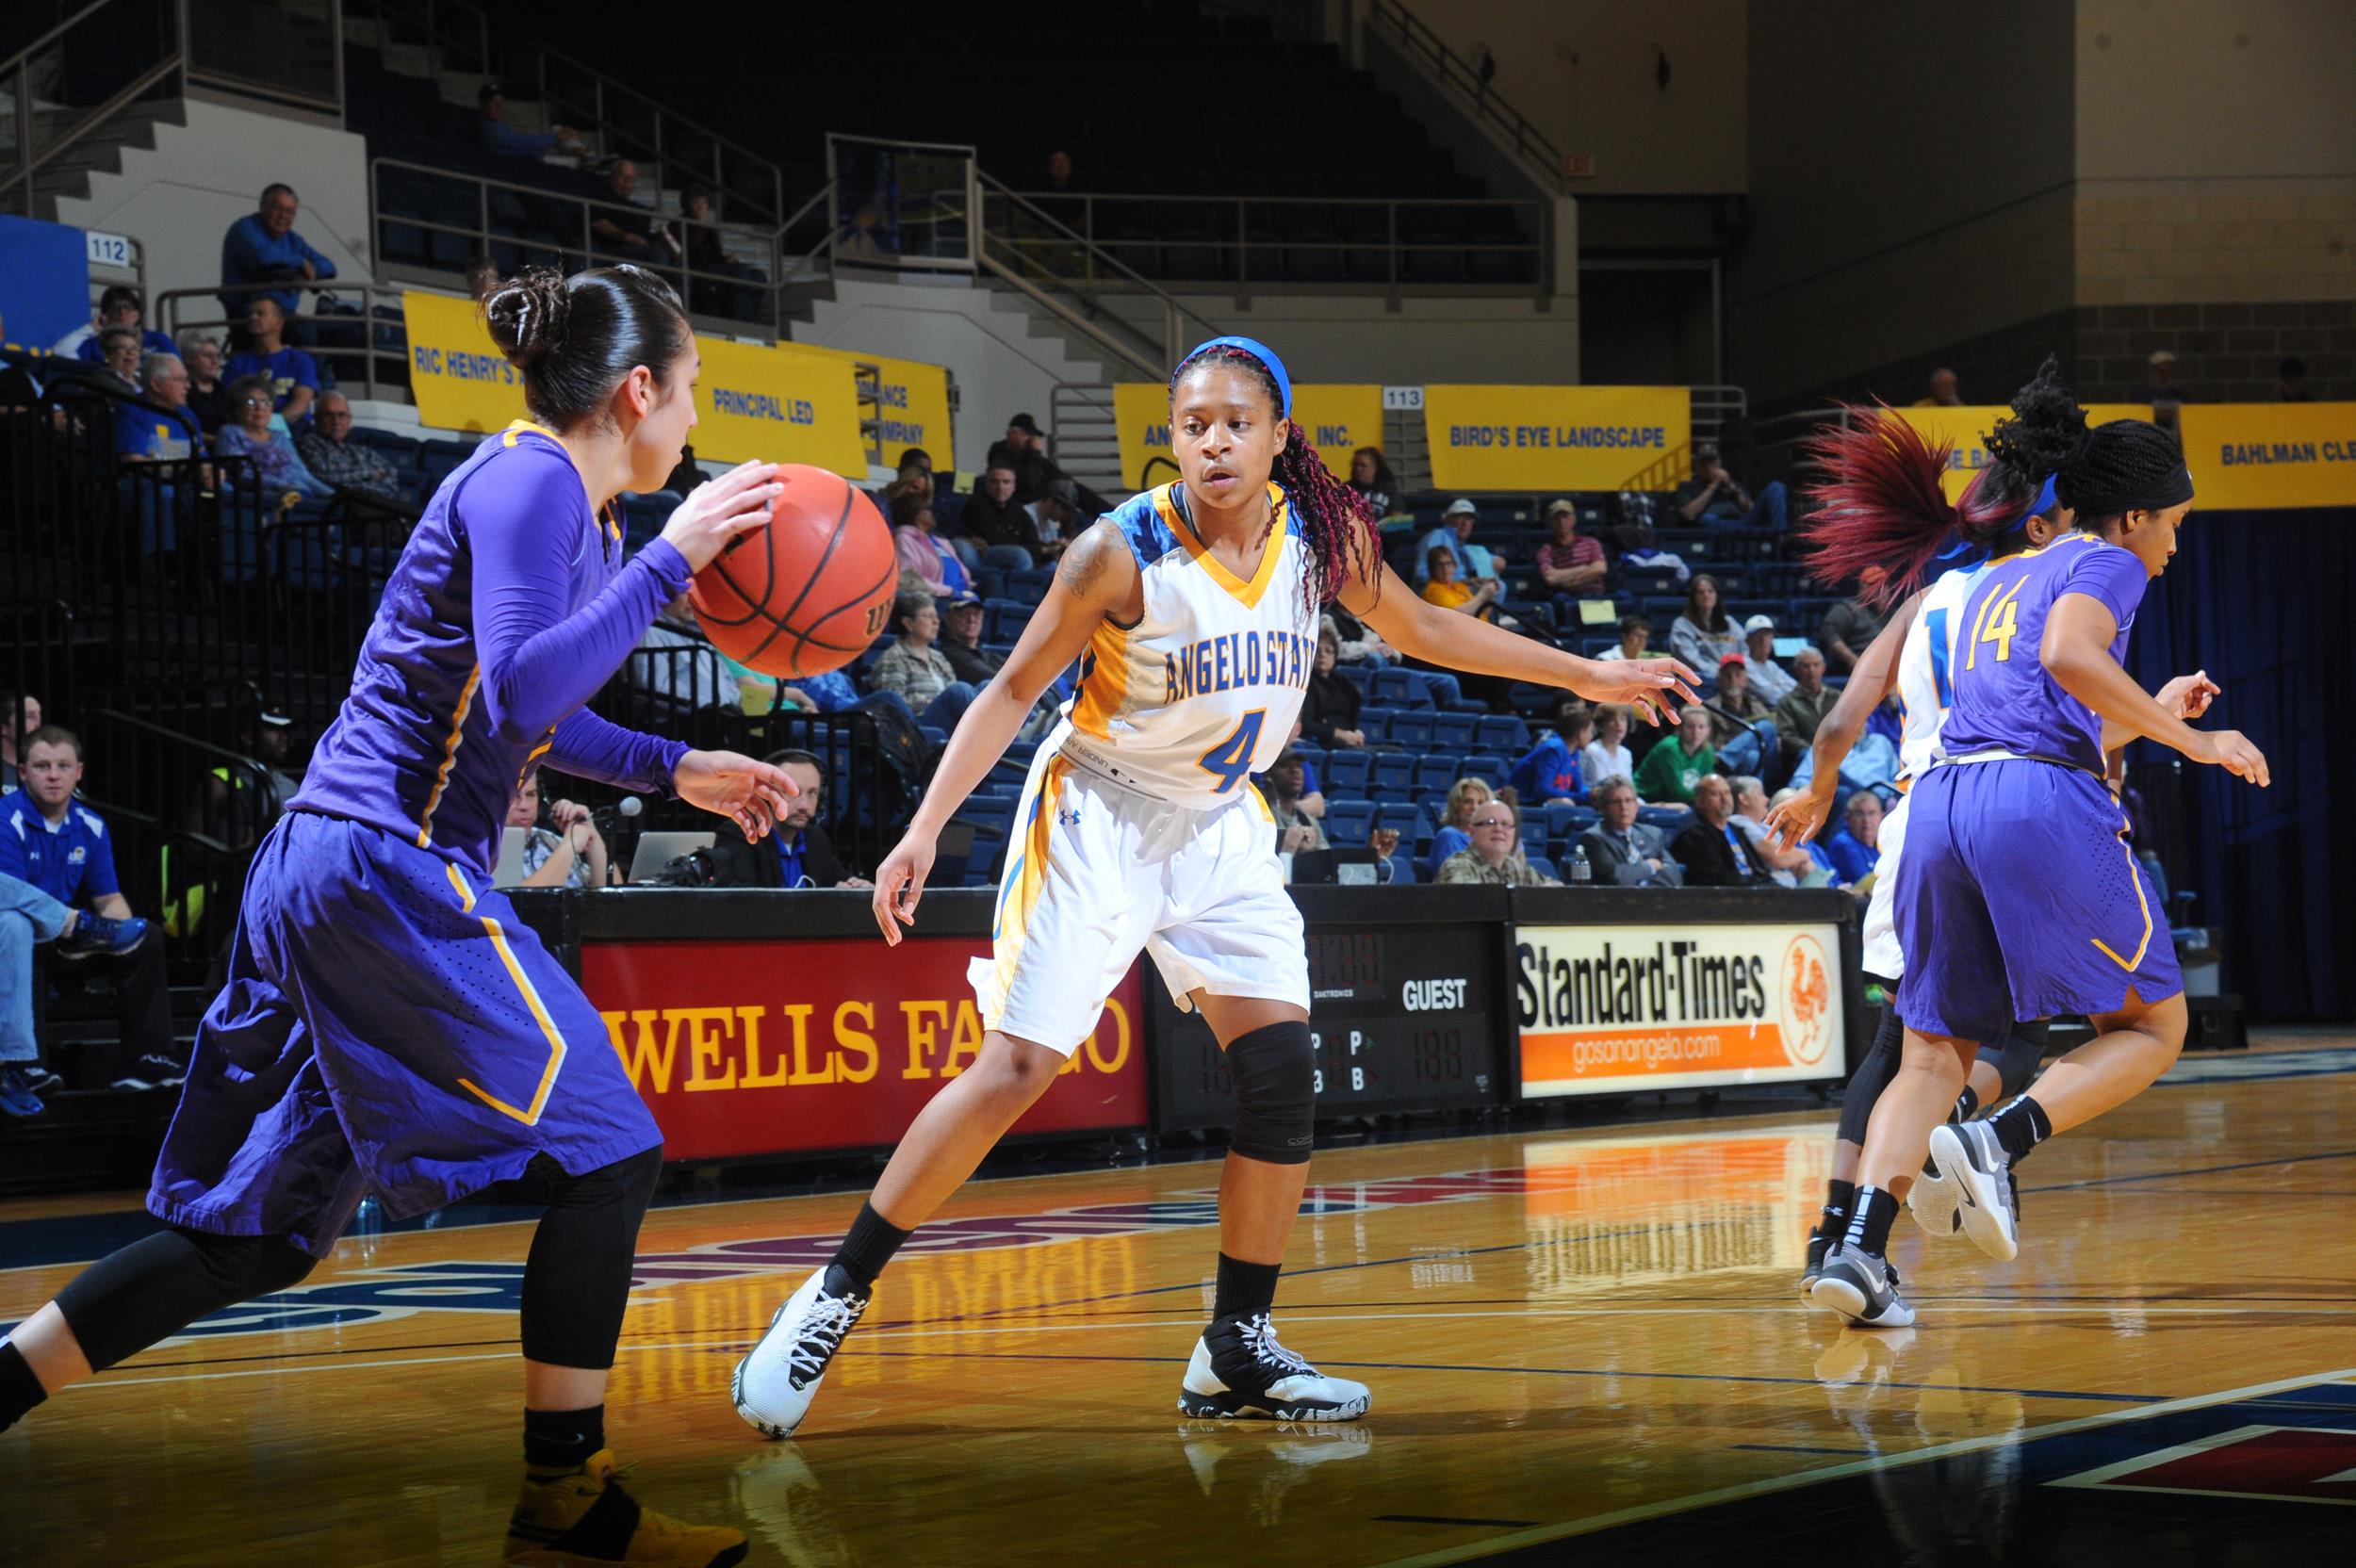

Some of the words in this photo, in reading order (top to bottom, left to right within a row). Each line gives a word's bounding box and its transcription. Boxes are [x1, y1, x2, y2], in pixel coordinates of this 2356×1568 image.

[92, 239, 125, 261] 112
[415, 346, 441, 374] RIC
[447, 350, 514, 384] HENRY'S
[713, 388, 784, 421] PRINCIPAL
[788, 399, 814, 425] LED
[1387, 390, 1421, 406] 113
[1317, 425, 1354, 447] INC.
[1449, 426, 1511, 448] BIRD'S
[1516, 426, 1550, 448] EYE
[1557, 426, 1665, 448] LANDSCAPE
[2221, 442, 2317, 466] BAHLMAN
[1965, 574, 2031, 672] 14
[1164, 630, 1261, 705] ANGELO
[1194, 707, 1268, 795] 4
[1402, 978, 1467, 1011] GUEST
[1515, 941, 1765, 1028] Standard-Times
[598, 1000, 879, 1094] WELLS
[899, 997, 1131, 1080] FAO
[1350, 1031, 1362, 1055] P
[1573, 1031, 1721, 1072] gosanangelo.com
[1351, 1067, 1364, 1090] B
